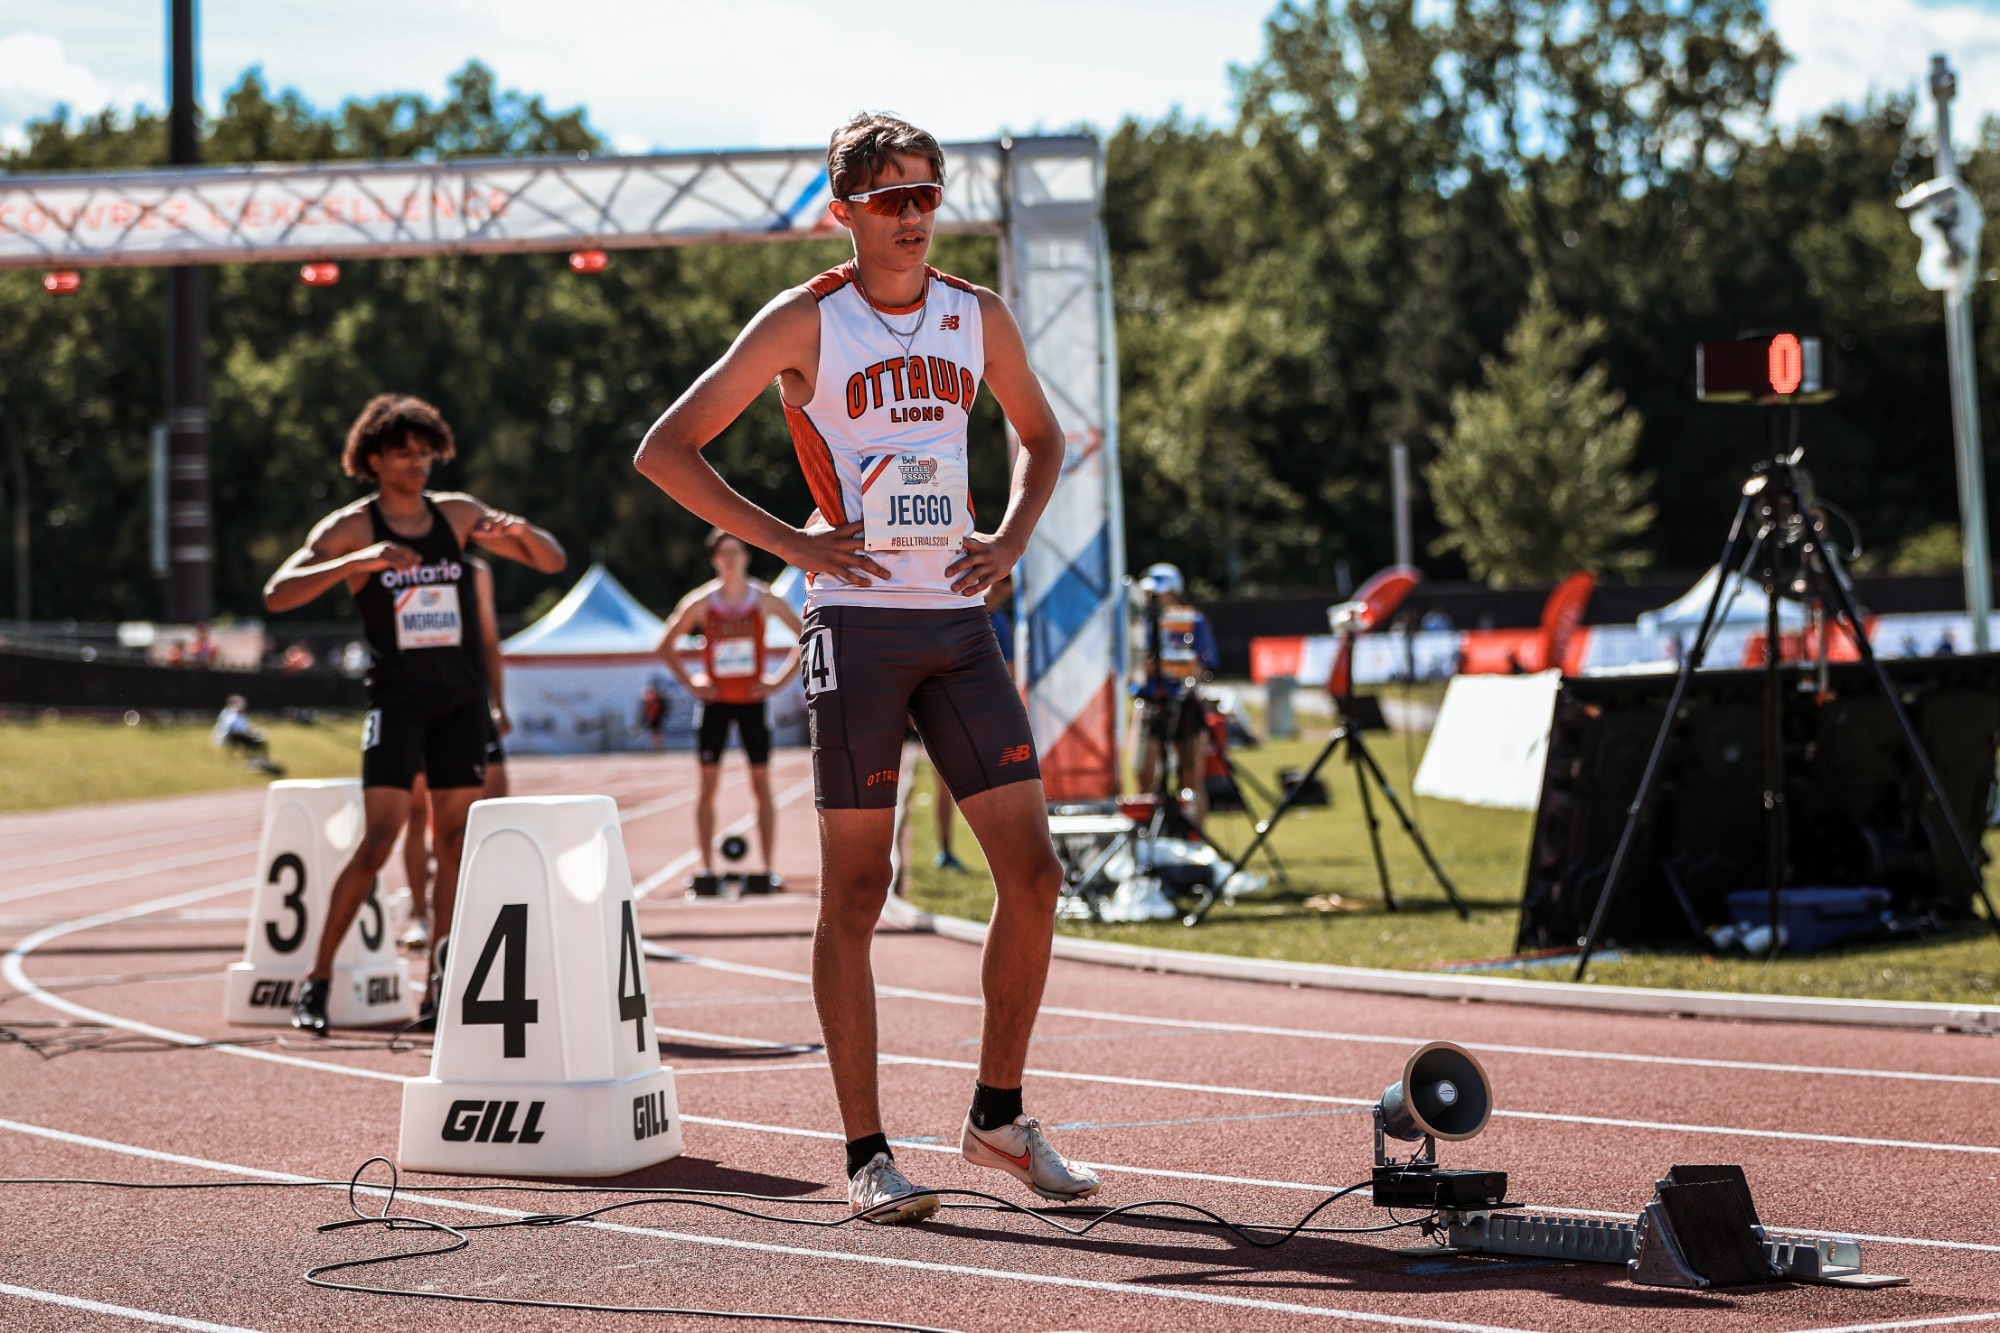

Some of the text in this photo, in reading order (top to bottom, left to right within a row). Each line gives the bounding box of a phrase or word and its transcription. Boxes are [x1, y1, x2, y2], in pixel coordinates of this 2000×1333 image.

[1769, 333, 1802, 394] 0
[846, 356, 975, 420] OTTAWA
[890, 406, 944, 423] LIONS
[901, 455, 917, 465] Bell
[902, 473, 931, 481] ESSAIS
[887, 495, 951, 526] JEGGO
[812, 633, 830, 688] 4
[265, 852, 307, 954] 3
[250, 979, 300, 1008] GIL
[368, 976, 401, 1006] GILL
[462, 903, 538, 1058] 4
[618, 900, 647, 1053] 4
[441, 1100, 545, 1144] GILL
[633, 1090, 669, 1141] GILL
